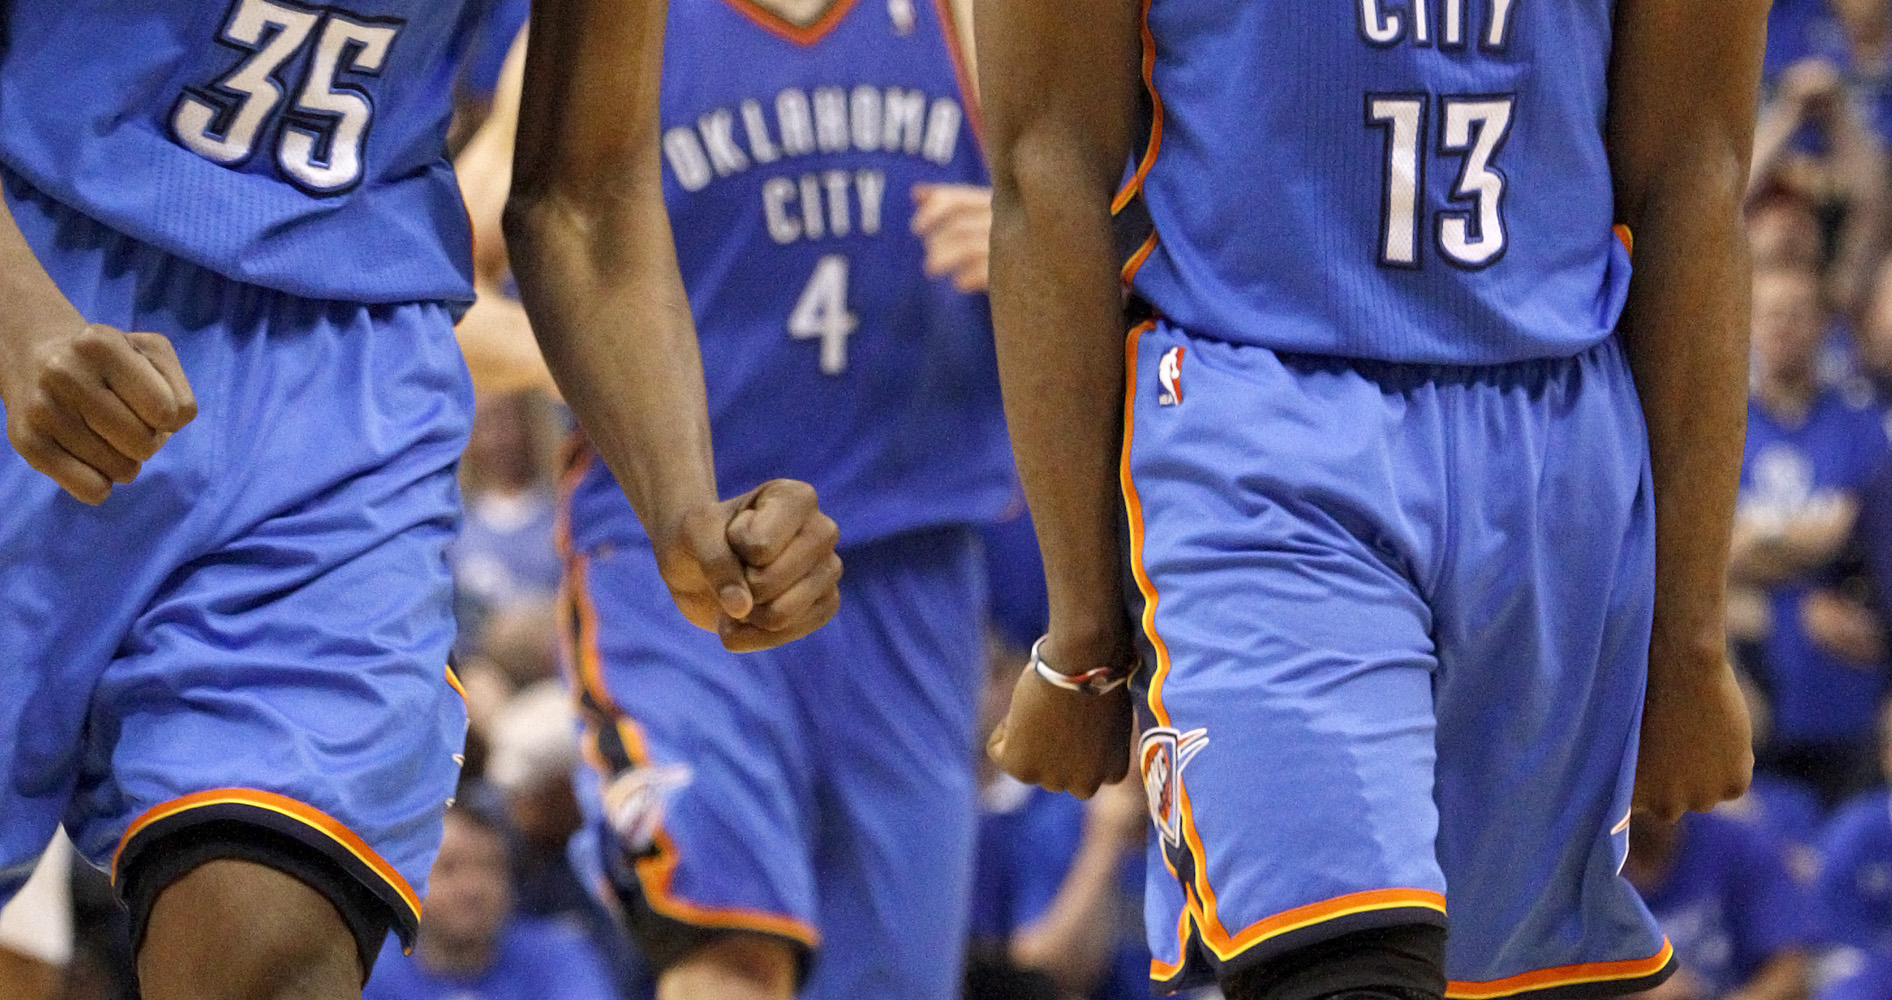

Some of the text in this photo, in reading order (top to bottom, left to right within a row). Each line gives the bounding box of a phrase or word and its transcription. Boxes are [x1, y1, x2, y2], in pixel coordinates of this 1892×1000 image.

[663, 86, 962, 192] OKLAHOMA
[1366, 92, 1515, 269] 13
[761, 169, 886, 245] CITY
[787, 252, 860, 375] 4
